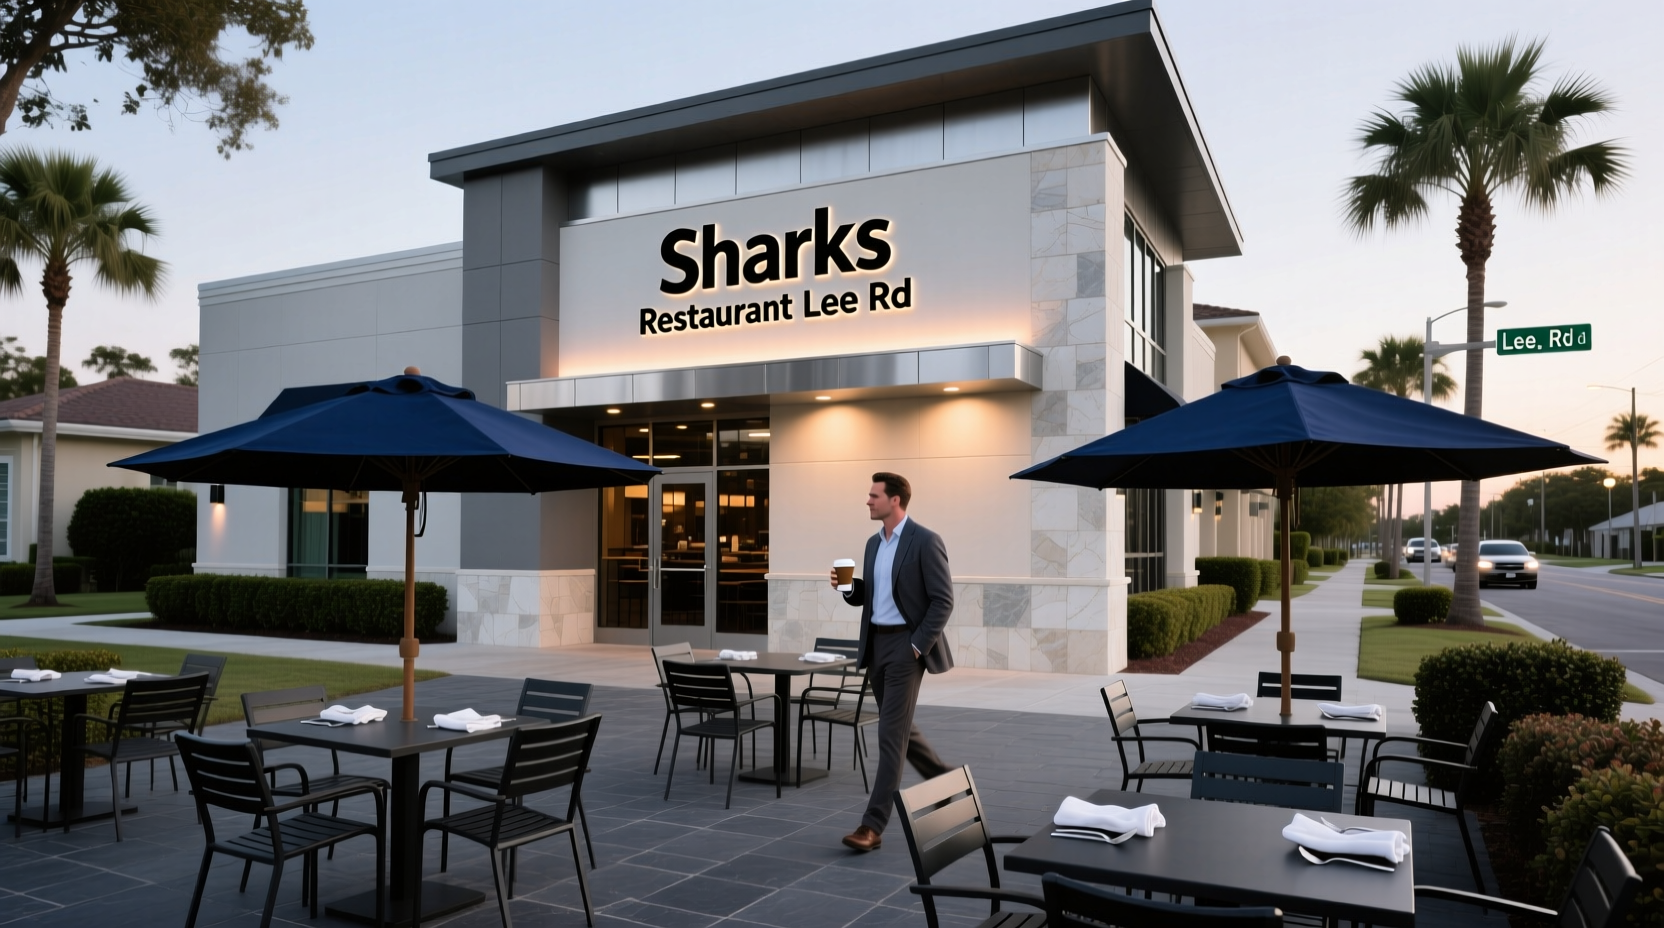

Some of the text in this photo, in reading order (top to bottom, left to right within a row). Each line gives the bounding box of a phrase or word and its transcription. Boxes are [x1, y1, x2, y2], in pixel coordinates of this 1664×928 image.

[660, 207, 891, 295] Sharks
[640, 277, 911, 335] Restaurant Lee Rd
[1502, 332, 1542, 350] Lee.
[1549, 328, 1573, 348] Rd
